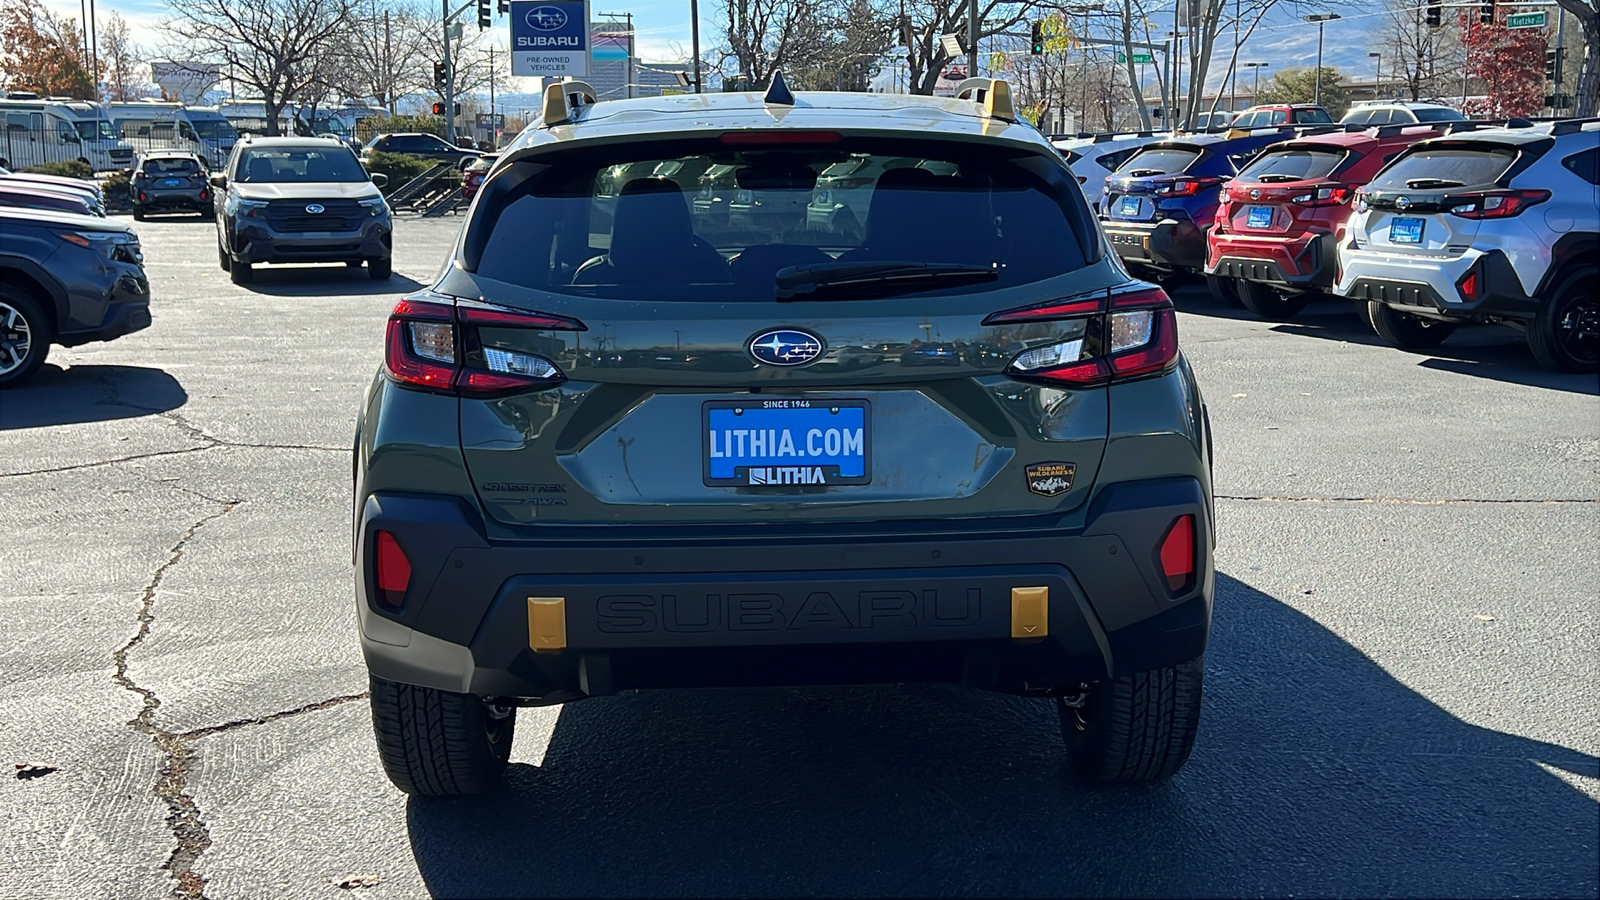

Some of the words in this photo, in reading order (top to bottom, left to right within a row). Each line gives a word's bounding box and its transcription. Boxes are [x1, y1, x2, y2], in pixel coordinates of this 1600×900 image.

[517, 36, 579, 46] SUBARU
[526, 56, 570, 64] PRE-OWNED
[710, 428, 864, 458] LITHIA.COM
[767, 467, 826, 484] LITHIA
[482, 482, 567, 493] CROSSTREK
[520, 497, 568, 506] AWD
[596, 588, 982, 634] SUBARU
